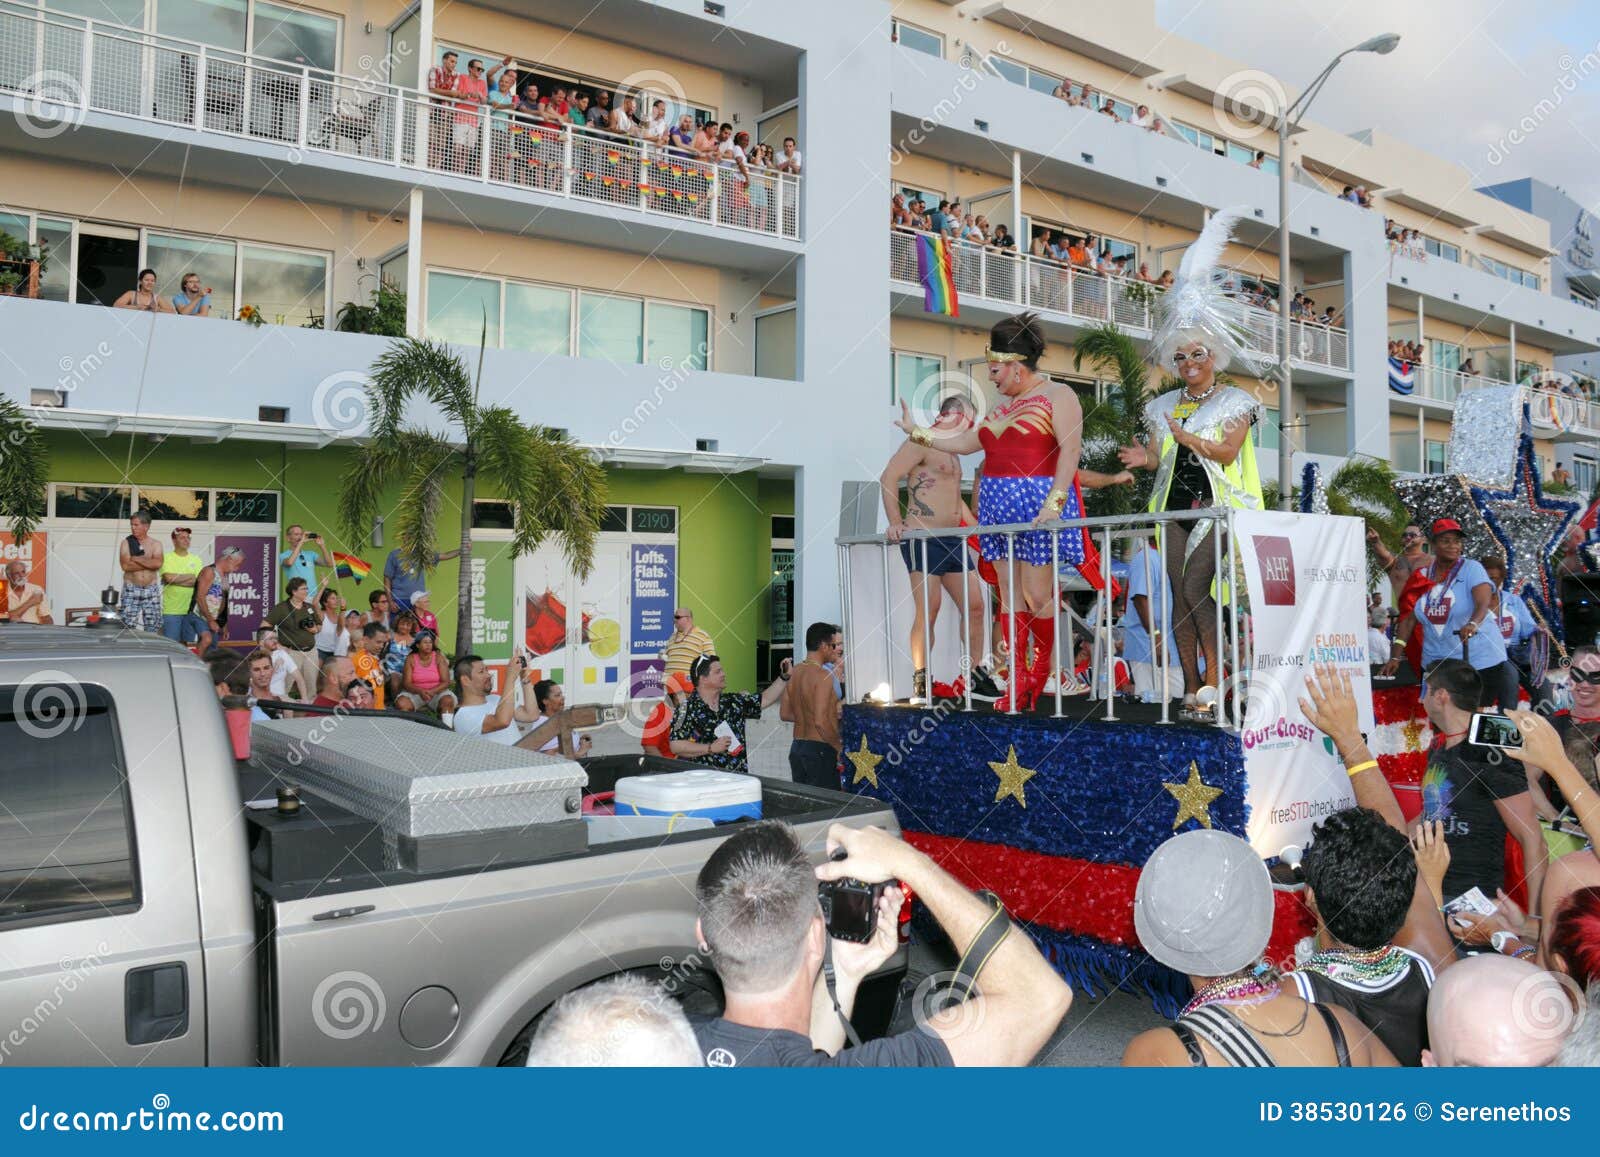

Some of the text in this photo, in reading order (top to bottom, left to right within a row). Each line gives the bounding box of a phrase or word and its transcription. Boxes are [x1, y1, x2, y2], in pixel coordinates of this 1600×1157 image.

[224, 498, 269, 517] 2192
[638, 511, 670, 529] 2190
[635, 550, 668, 565] Lofts.
[635, 565, 668, 579] Flats.
[1265, 556, 1290, 581] AHF
[228, 572, 253, 585] ive.
[635, 578, 659, 590] Town
[228, 586, 261, 600] ork.
[635, 588, 670, 599] homes.
[228, 602, 254, 618] lay.
[1427, 604, 1447, 617] AHF
[485, 617, 510, 631] Your
[1501, 622, 1512, 632] HF
[485, 631, 508, 644] Life
[1315, 632, 1358, 648] FLORIDA
[1243, 726, 1270, 749] OUT
[1277, 716, 1315, 742] CLOSET
